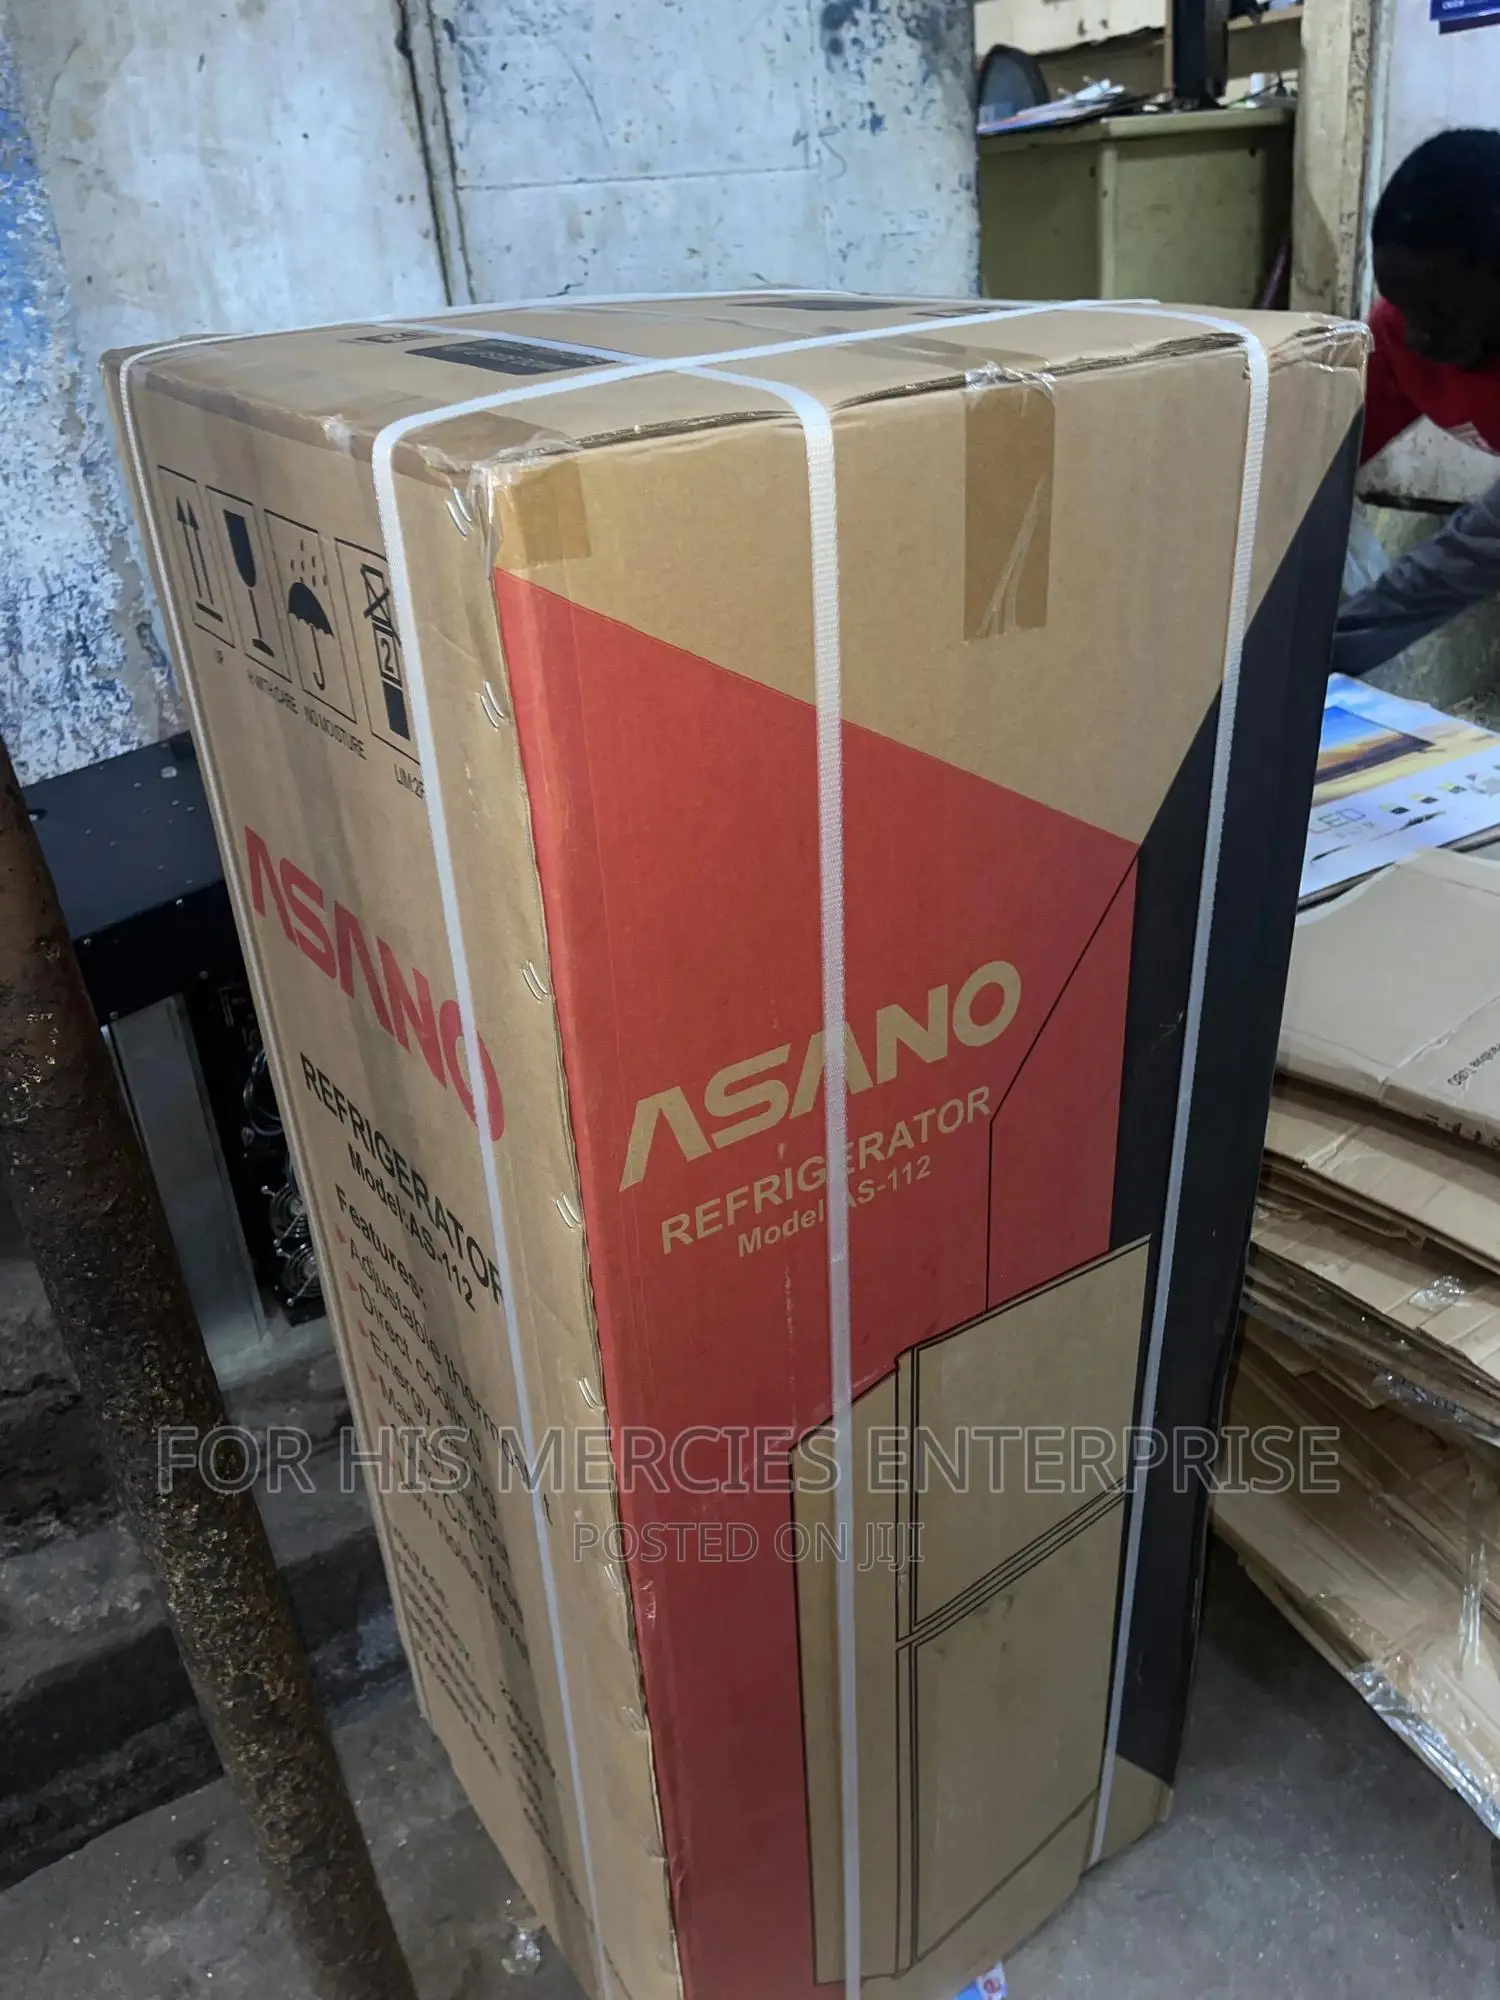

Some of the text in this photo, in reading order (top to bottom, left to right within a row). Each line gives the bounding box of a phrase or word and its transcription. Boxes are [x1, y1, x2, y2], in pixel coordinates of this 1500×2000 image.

[244, 825, 505, 1141] ASANO
[619, 960, 1021, 1192] ASANO
[350, 1237, 442, 1365] Adjustable
[358, 1282, 412, 1364] Direct
[368, 1329, 431, 1427] Energy
